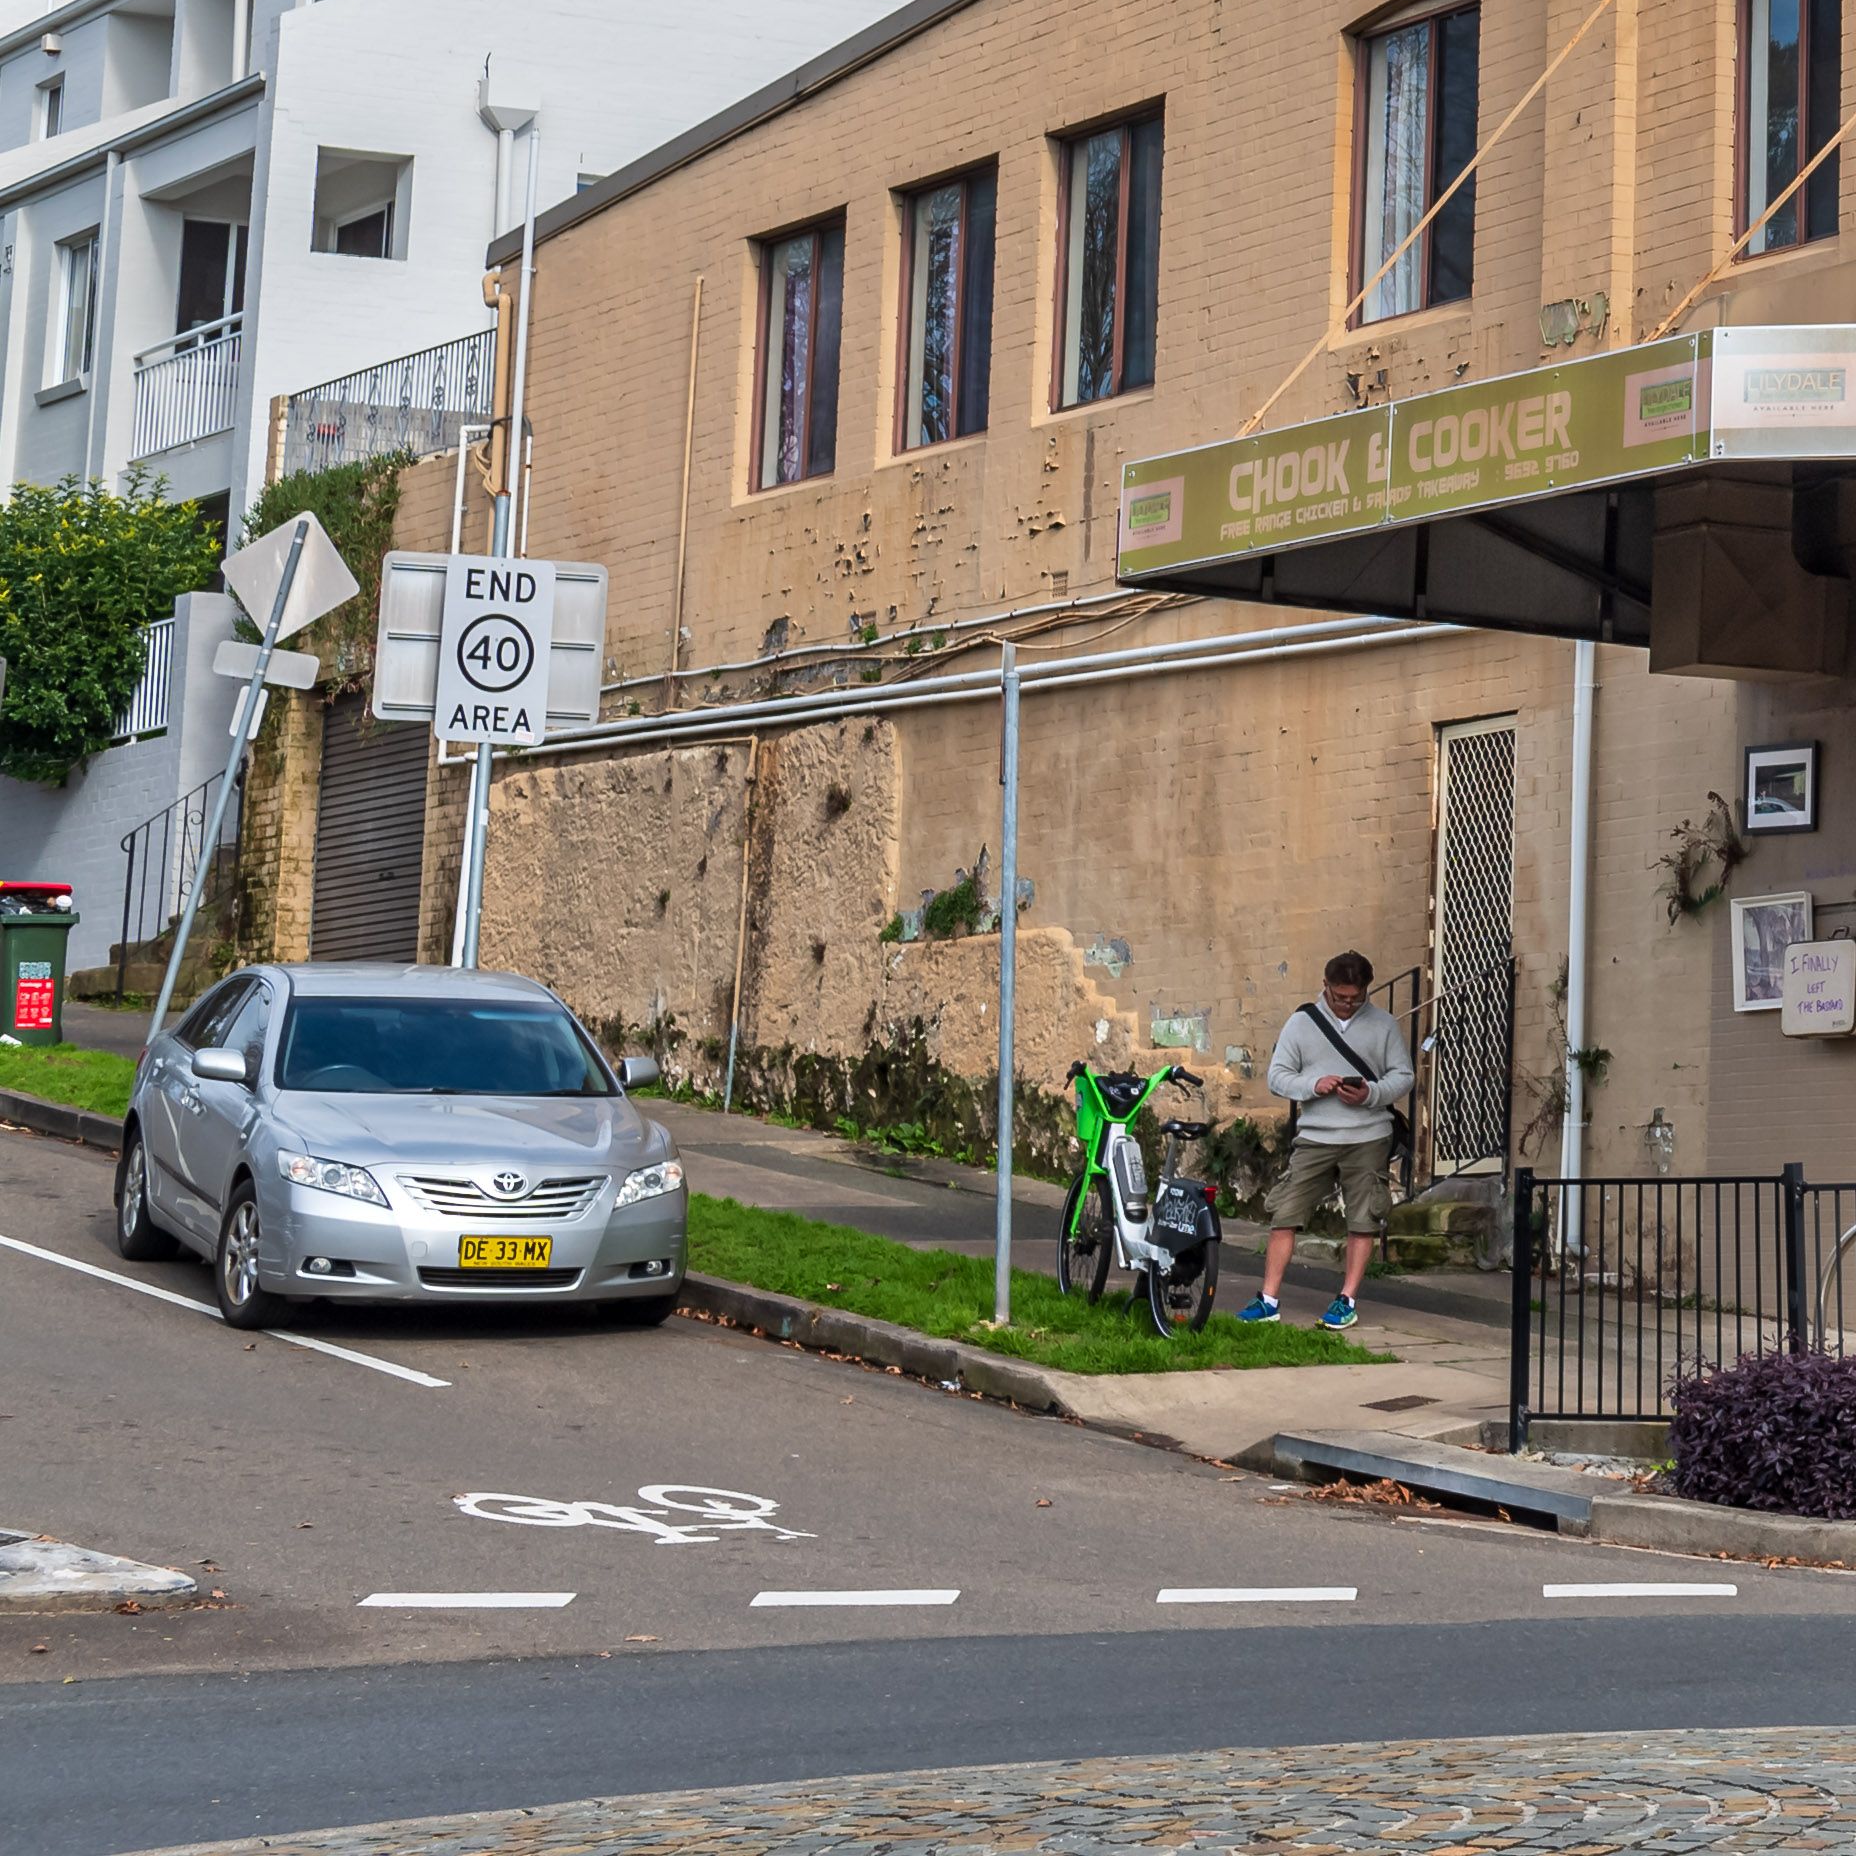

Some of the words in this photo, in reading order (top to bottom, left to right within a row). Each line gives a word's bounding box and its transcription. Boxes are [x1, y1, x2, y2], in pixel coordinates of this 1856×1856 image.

[1748, 372, 1842, 392] LILYDALE
[1228, 438, 1350, 515] CHOOK
[1366, 431, 1389, 483] &
[1408, 390, 1573, 473] COOKER
[1220, 519, 1251, 541] FREE
[1254, 509, 1292, 535] RANGE
[1295, 500, 1350, 524] CHICKEN
[1417, 467, 1480, 500] TAKEAWAY
[1504, 457, 1540, 481] 9692
[1544, 449, 1580, 474] 9760
[465, 568, 537, 603] END
[466, 635, 521, 672] 40
[448, 703, 531, 734] AREA
[1801, 953, 1839, 974] FINALLY
[1806, 980, 1826, 994] LEFT
[1797, 1001, 1813, 1015] THE
[464, 1240, 489, 1260] DE
[495, 1240, 518, 1261] 33
[523, 1241, 548, 1261] MX
